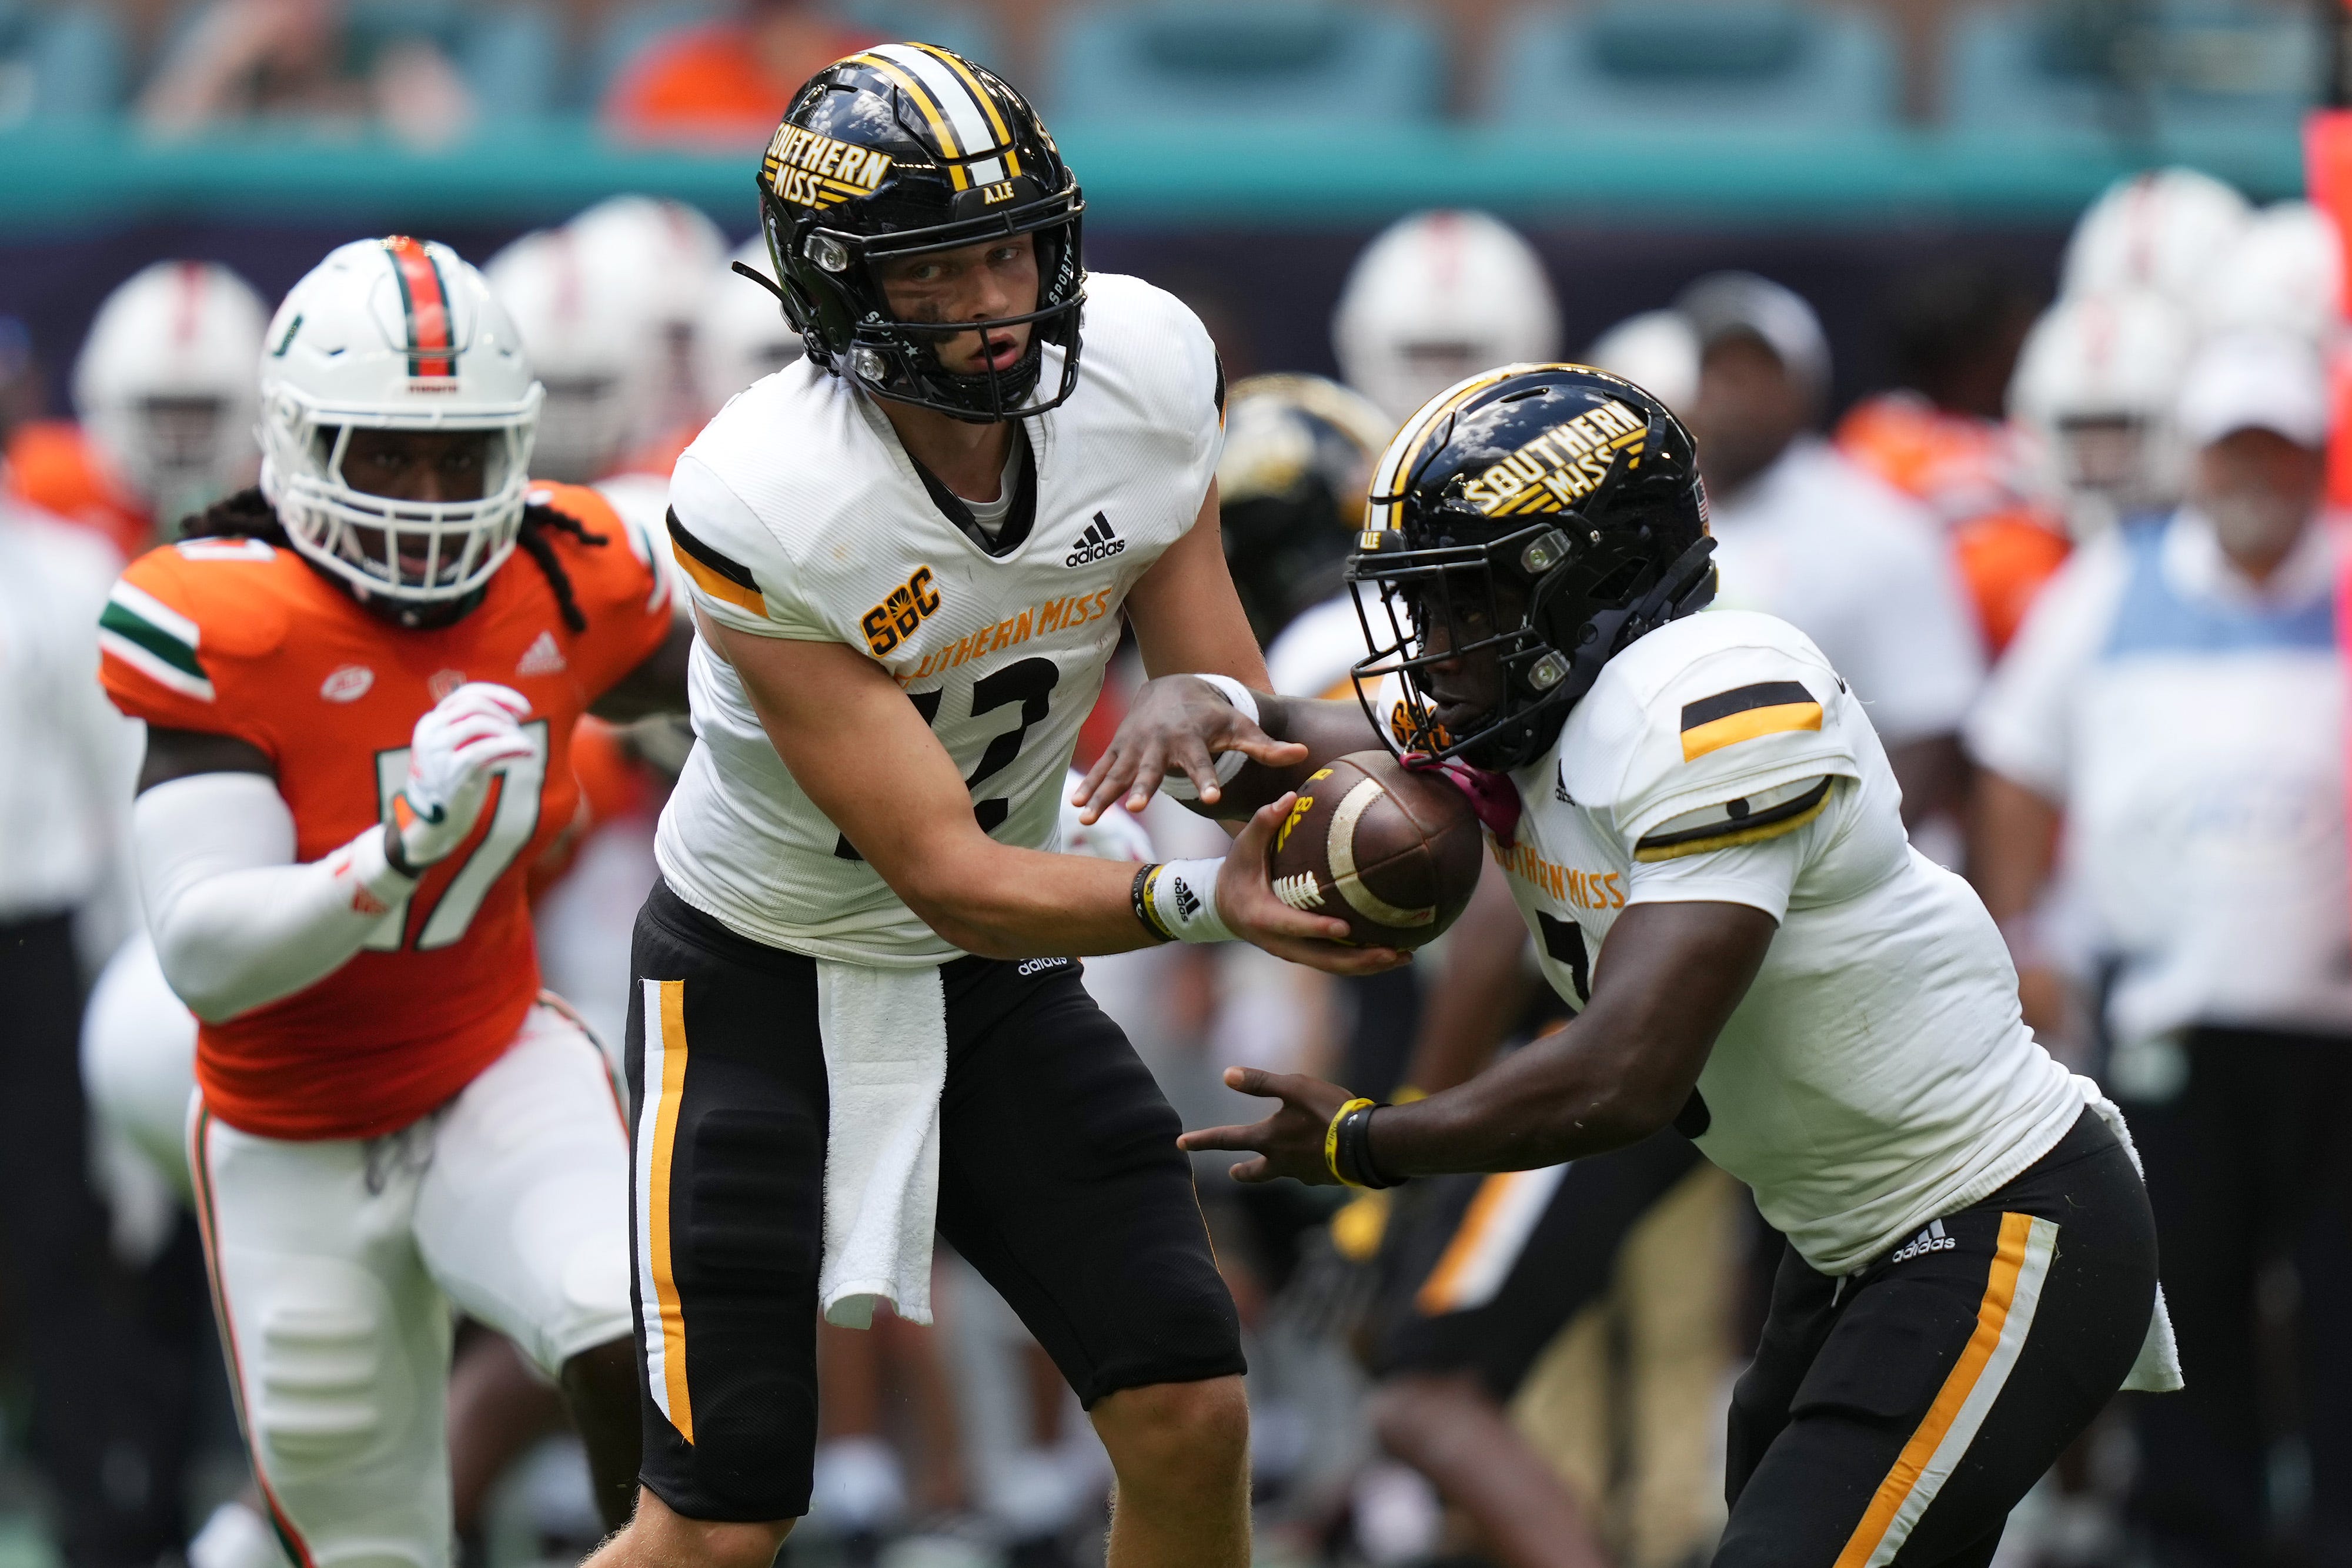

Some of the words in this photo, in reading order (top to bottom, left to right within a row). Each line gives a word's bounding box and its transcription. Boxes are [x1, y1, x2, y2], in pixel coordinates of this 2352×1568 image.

[767, 122, 893, 190] SOUTHERN
[773, 162, 824, 207] MISS
[1048, 253, 1072, 306] SPORT
[1463, 400, 1646, 516] SOUTHERN
[1065, 539, 1125, 567] adidas
[860, 564, 942, 658] SBC
[894, 607, 1034, 688] UTHERN
[1037, 587, 1112, 635] MISS
[1174, 876, 1188, 922] adidas
[1892, 1237, 1956, 1263] adidas
